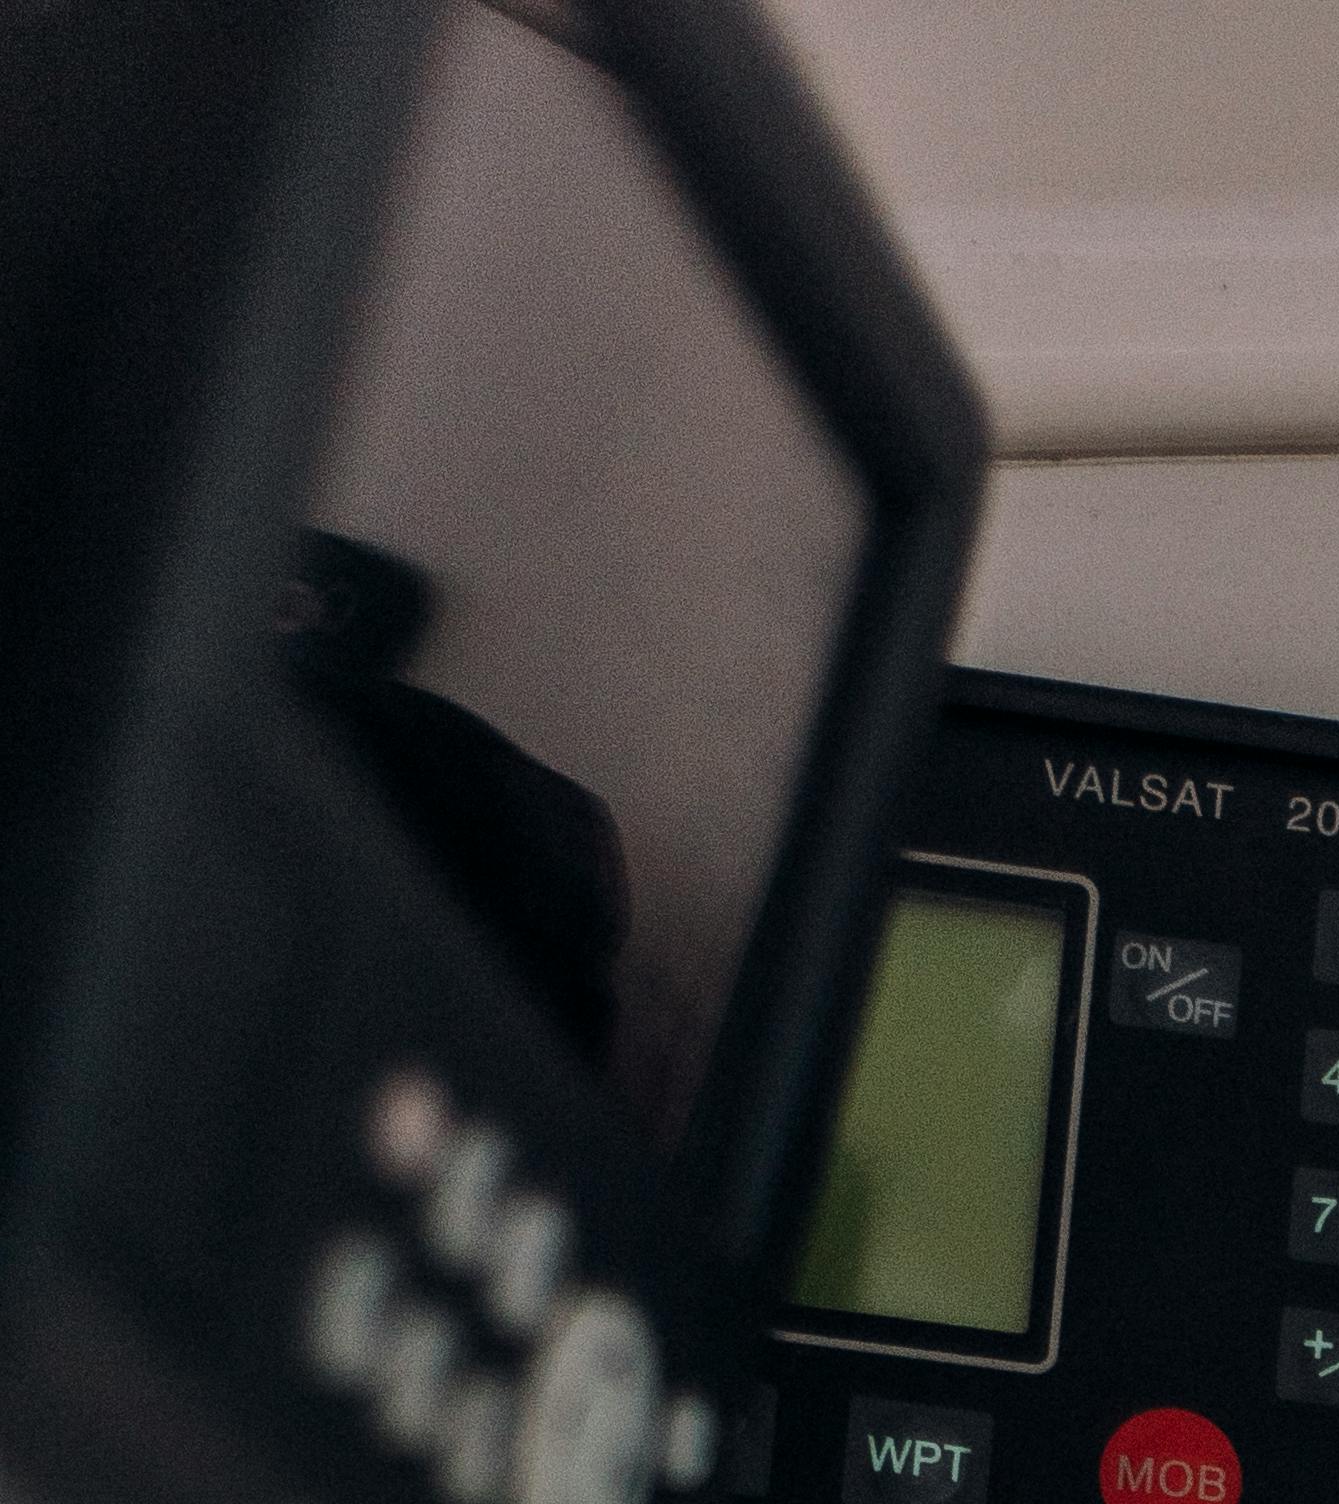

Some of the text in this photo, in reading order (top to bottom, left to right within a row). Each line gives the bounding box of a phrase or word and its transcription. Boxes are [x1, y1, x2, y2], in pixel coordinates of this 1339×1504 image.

[1044, 759, 1234, 819] VALSAT
[1312, 1196, 1338, 1233] 7
[869, 1436, 970, 1482] WPT
[1118, 1455, 1226, 1503] MOB
